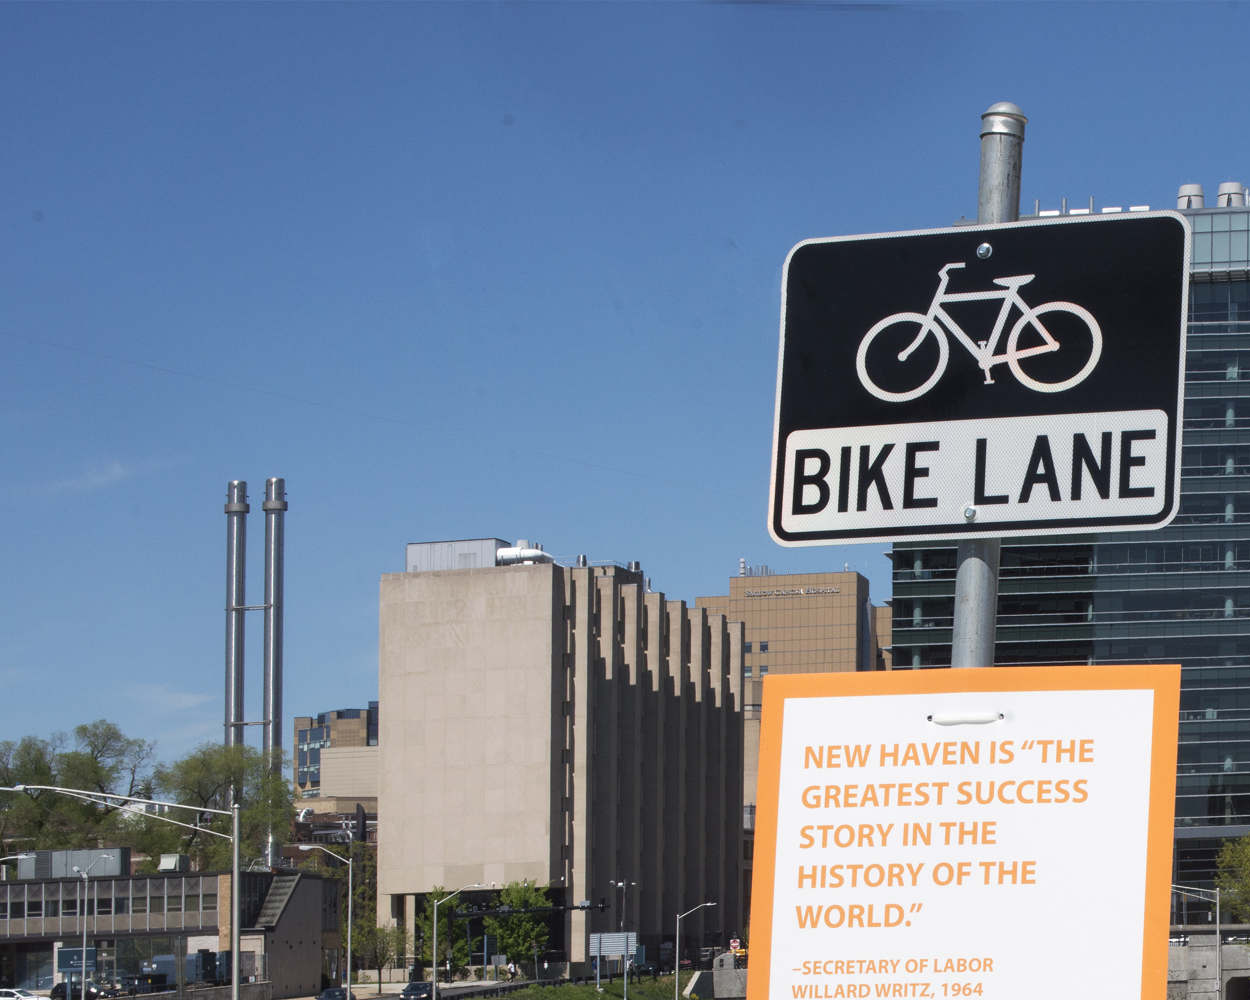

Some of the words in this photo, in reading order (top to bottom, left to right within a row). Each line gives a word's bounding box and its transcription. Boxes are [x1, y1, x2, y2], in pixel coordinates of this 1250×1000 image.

[791, 440, 940, 516] BIKE
[973, 429, 1157, 506] LANE
[803, 744, 872, 770] NEW
[879, 741, 981, 768] HAVEN
[989, 741, 1015, 765] IS
[801, 782, 951, 809] GREATEST
[956, 779, 1089, 806] SUCCESS
[799, 823, 895, 849] STORY
[901, 822, 932, 847] IN
[938, 821, 998, 847] THE
[797, 862, 925, 889] HISTORY
[932, 861, 973, 887] OF
[979, 860, 1037, 886] THE
[795, 903, 923, 929] WORLD.”
[904, 958, 929, 974] OF
[933, 957, 994, 974] LABOR
[791, 983, 872, 1000] WILLARD
[874, 982, 935, 1000] WRITZ,
[941, 982, 984, 998] 1964
